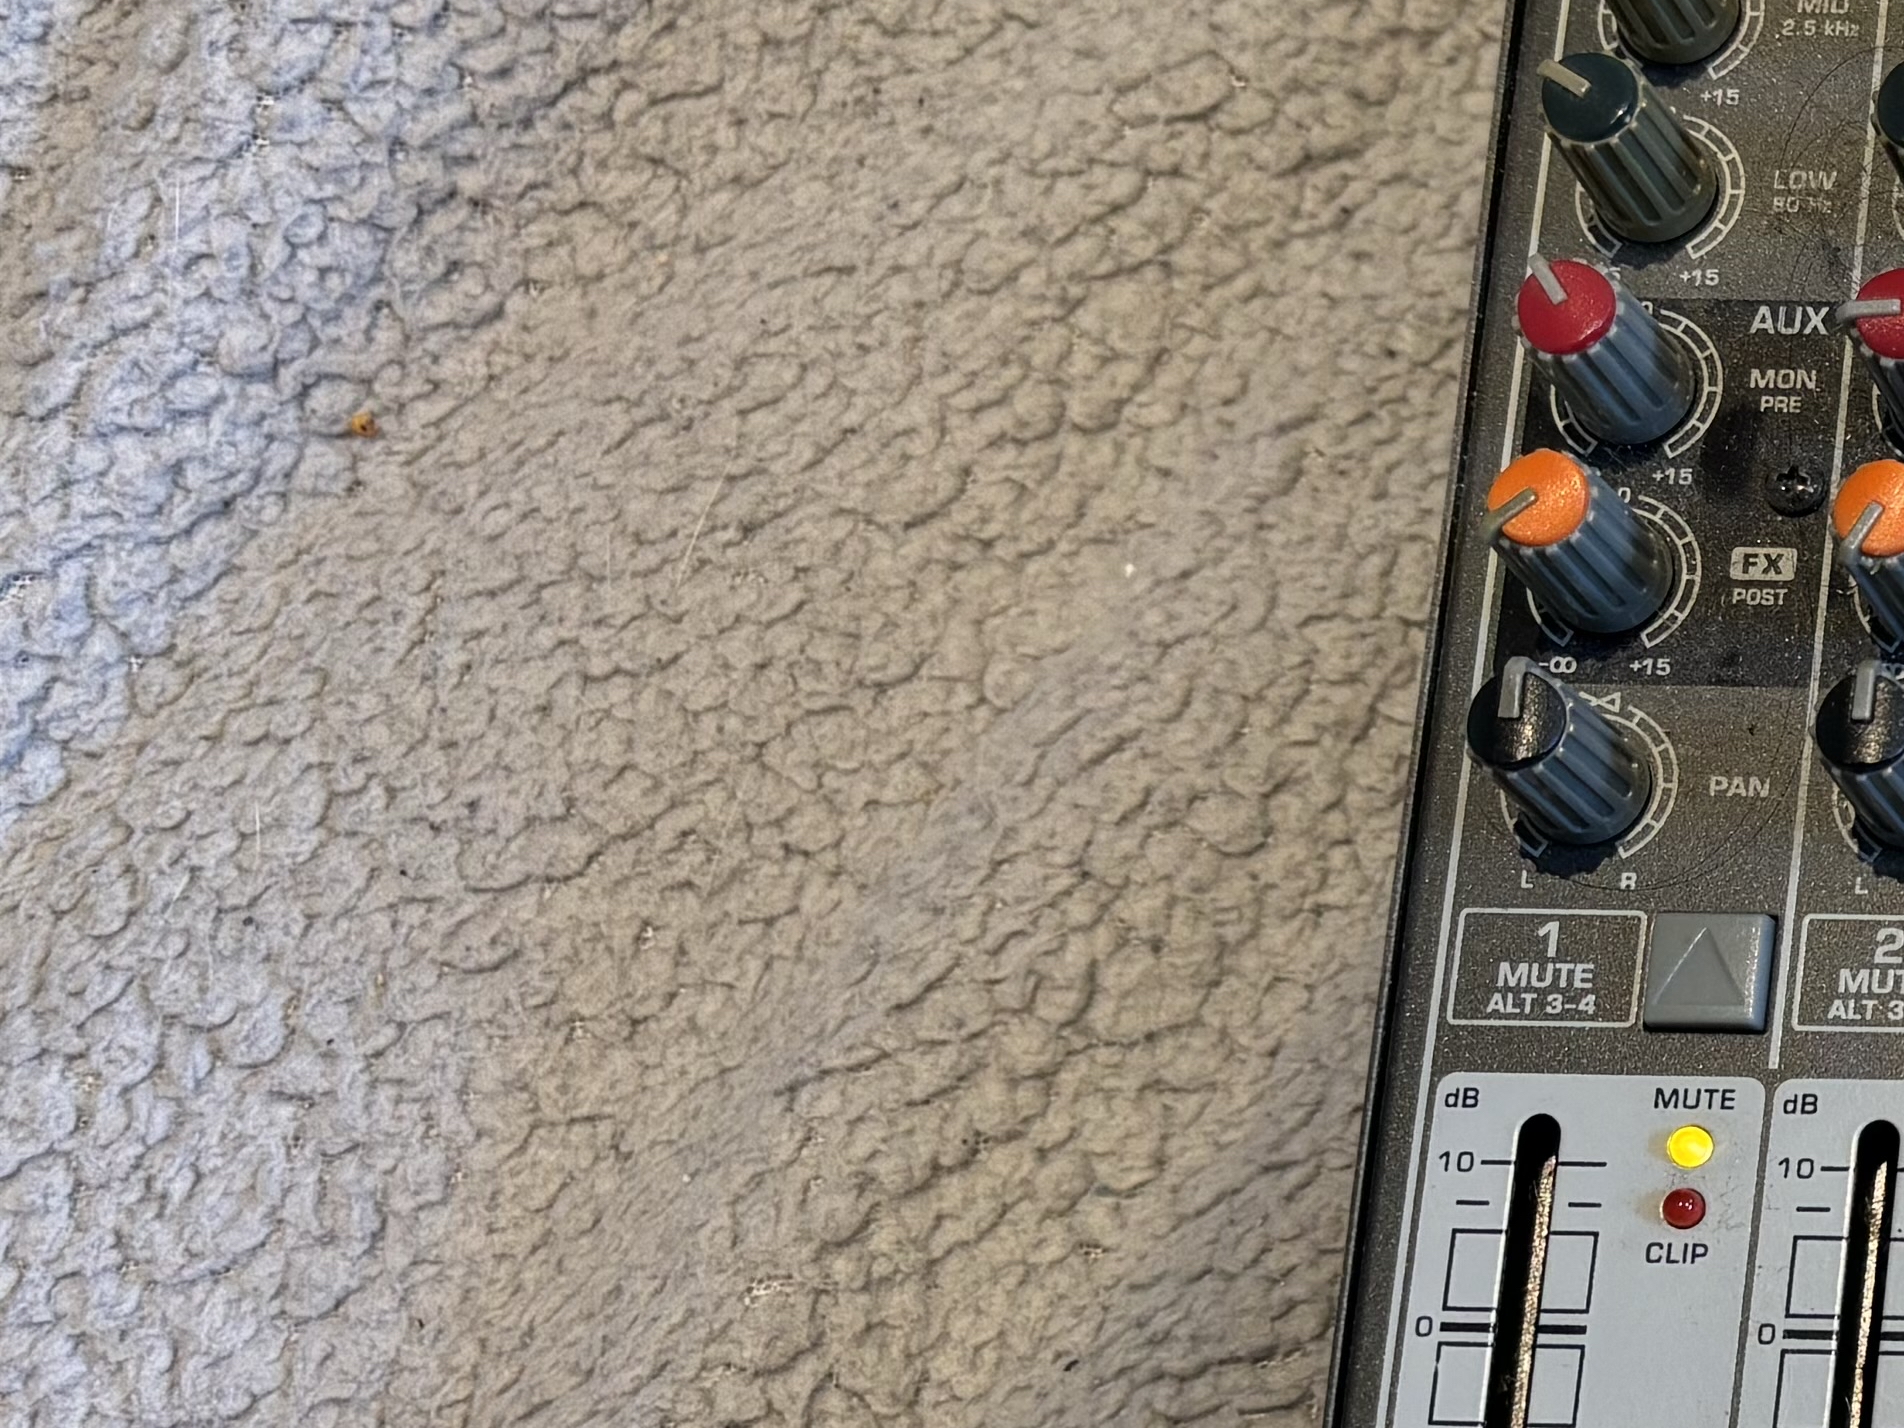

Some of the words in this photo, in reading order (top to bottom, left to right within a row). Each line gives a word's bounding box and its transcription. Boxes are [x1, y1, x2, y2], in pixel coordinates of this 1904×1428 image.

[1750, 307, 1829, 335] AUX
[1749, 370, 1816, 390] MON
[1760, 396, 1801, 413] PRE
[1742, 555, 1780, 575] FX
[1732, 588, 1788, 606] POST
[1708, 776, 1771, 798] PAN
[1537, 921, 1558, 958] 1
[1496, 962, 1594, 989] MUTE
[1486, 994, 1537, 1015] ALT
[1546, 993, 1596, 1015] 3-4
[1444, 1088, 1479, 1110] dB
[1654, 1088, 1736, 1110] MUTE
[1645, 1243, 1709, 1265] CLIP
